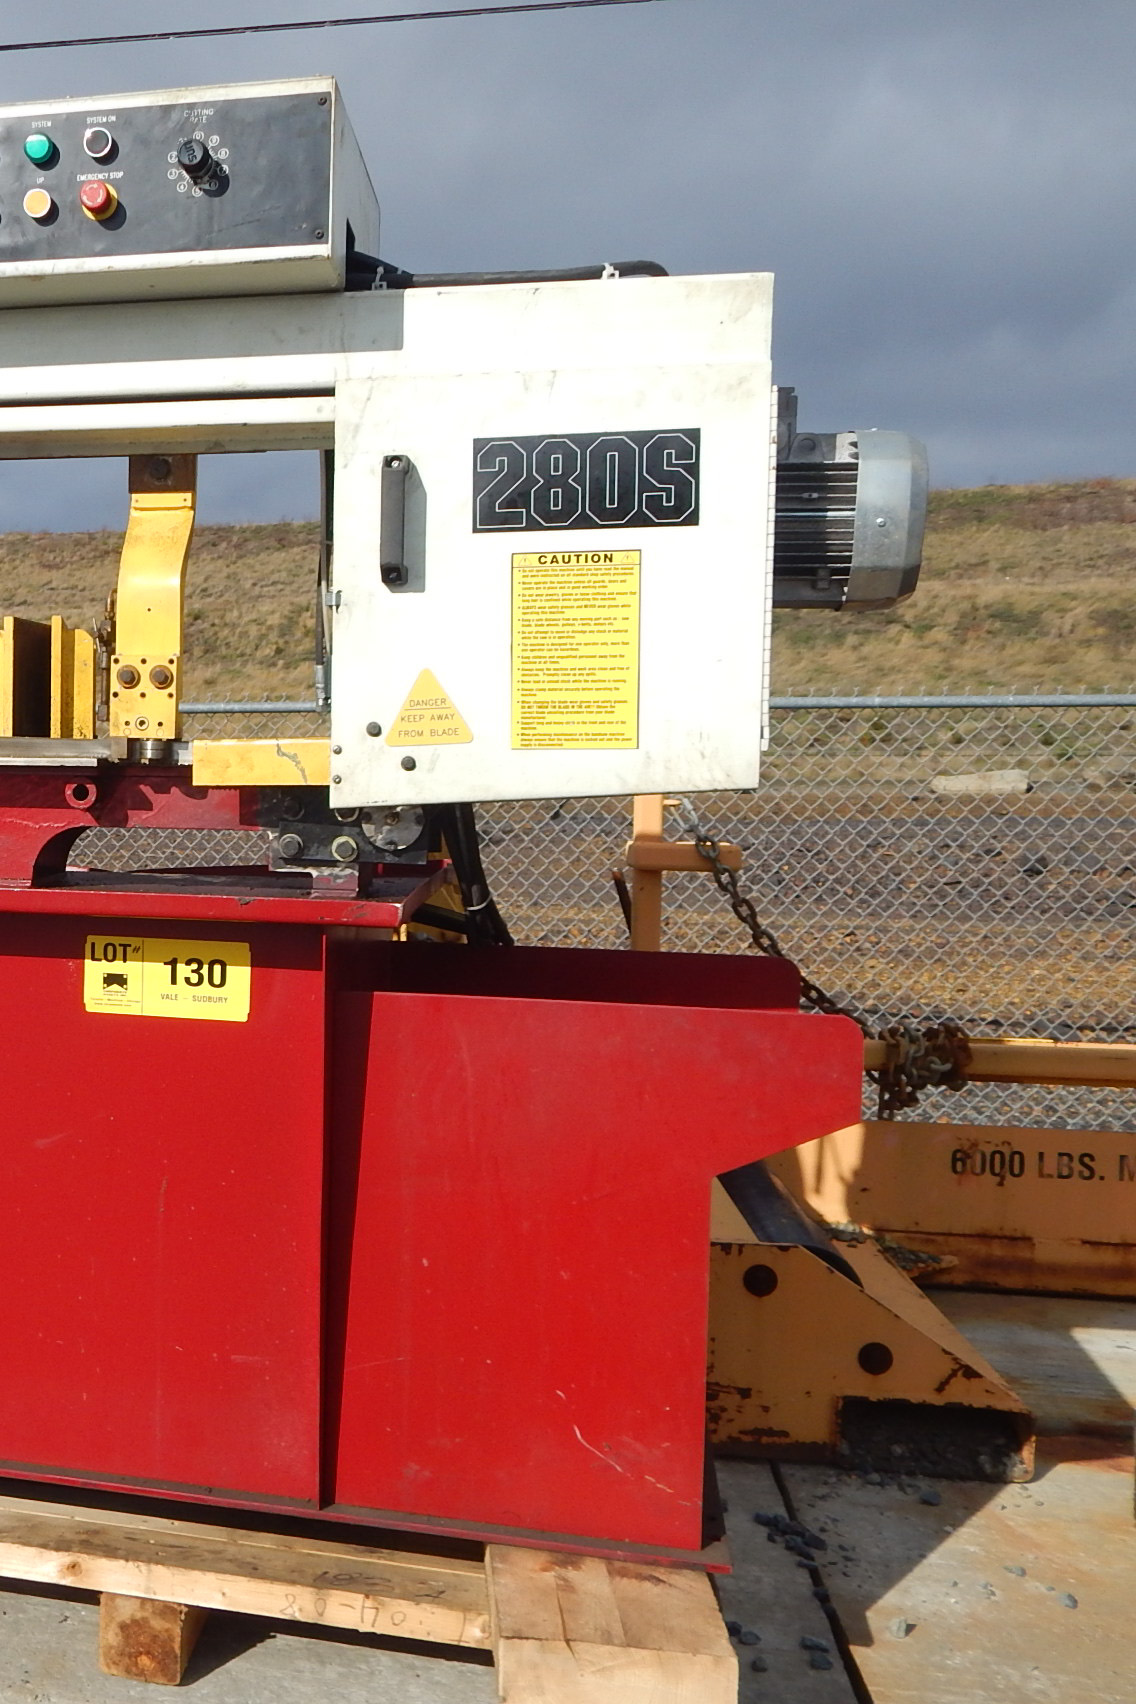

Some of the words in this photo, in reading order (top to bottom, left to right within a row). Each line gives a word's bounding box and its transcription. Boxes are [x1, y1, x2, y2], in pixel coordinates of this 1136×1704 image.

[31, 120, 52, 128] SYSTEM
[87, 116, 107, 124] SYSTEM
[36, 176, 45, 184] UP
[76, 172, 109, 182] EMERGENCY
[109, 171, 124, 180] STOP
[476, 432, 696, 529] 280S
[538, 553, 614, 565] CAUTION
[409, 698, 447, 708] DANGER
[400, 713, 425, 723] KEEP
[429, 713, 456, 722] AWAY
[397, 728, 425, 738] FROM
[429, 727, 460, 737] BLADE
[163, 957, 228, 989] 130
[160, 992, 179, 1001] VALE
[192, 994, 229, 1004] SUDBURY
[951, 1149, 1025, 1178] 6000
[1038, 1151, 1105, 1181] LBS.
